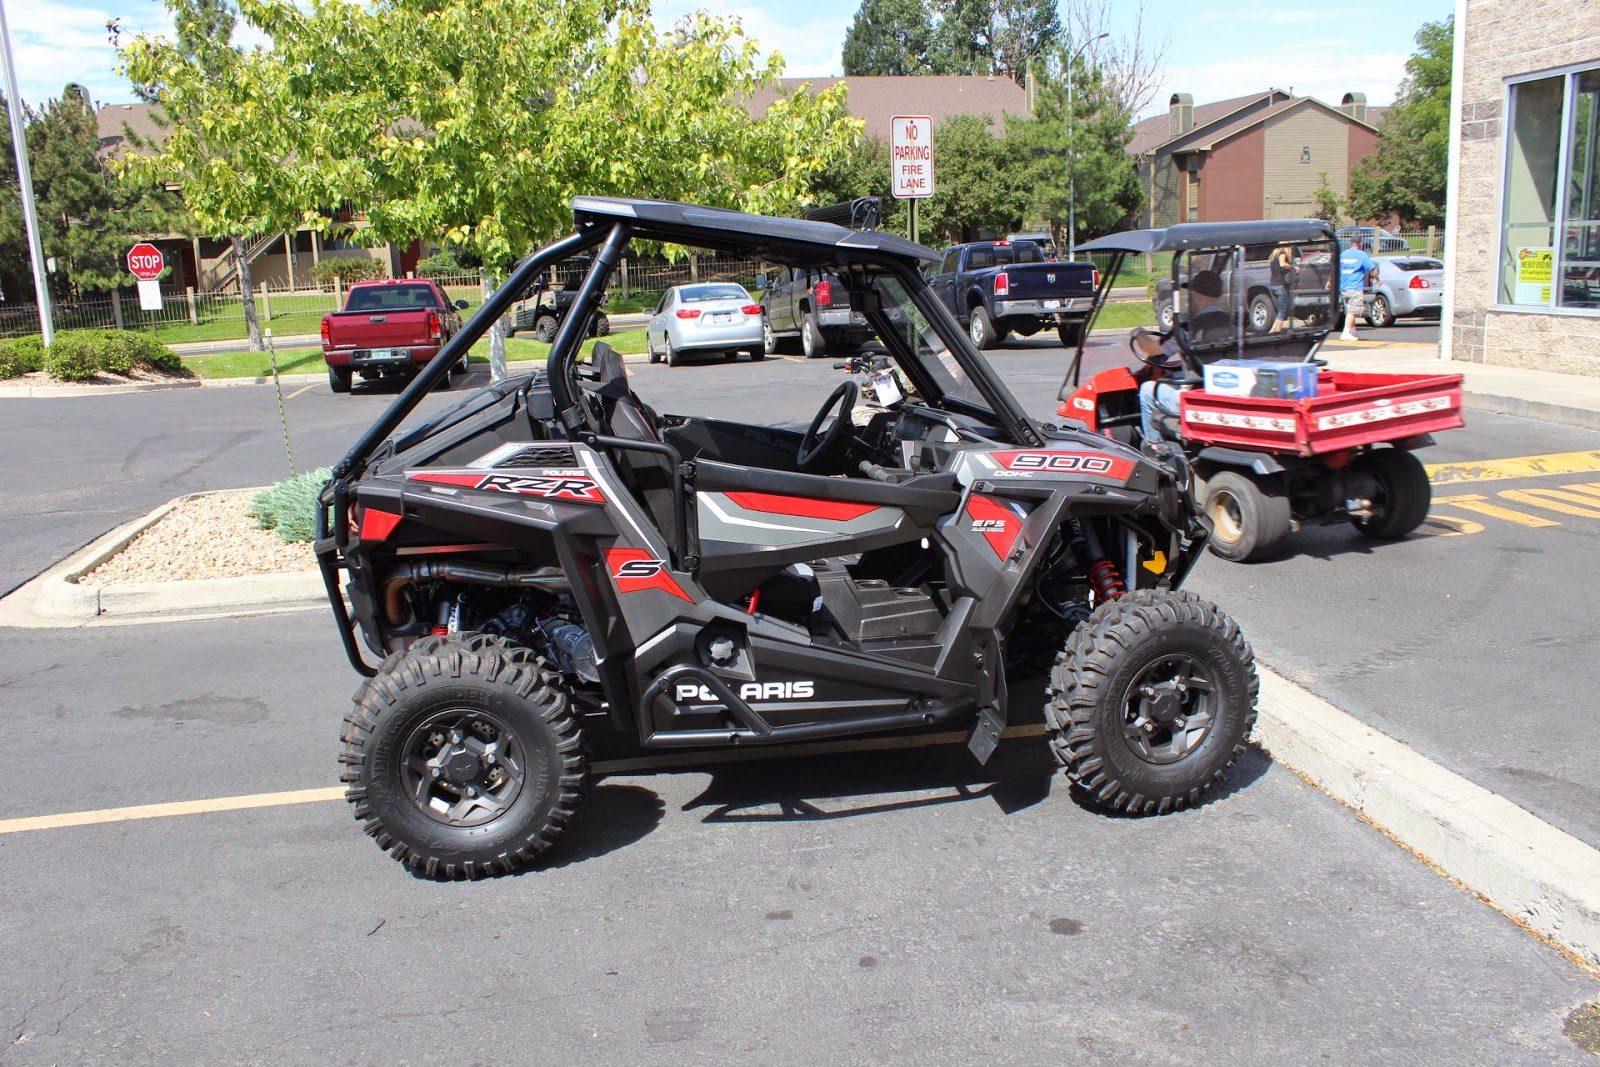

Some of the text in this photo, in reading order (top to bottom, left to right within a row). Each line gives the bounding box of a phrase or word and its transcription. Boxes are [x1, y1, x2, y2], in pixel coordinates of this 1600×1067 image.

[905, 125, 919, 140] NO
[895, 145, 930, 160] PARKING
[902, 164, 923, 175] FIRE
[900, 178, 926, 189] LANE
[131, 255, 160, 269] STOP
[1009, 453, 1114, 474] 900
[474, 473, 599, 498] RZR
[971, 519, 1007, 527] EPS
[612, 560, 667, 578] S
[675, 681, 815, 702] POARIS
